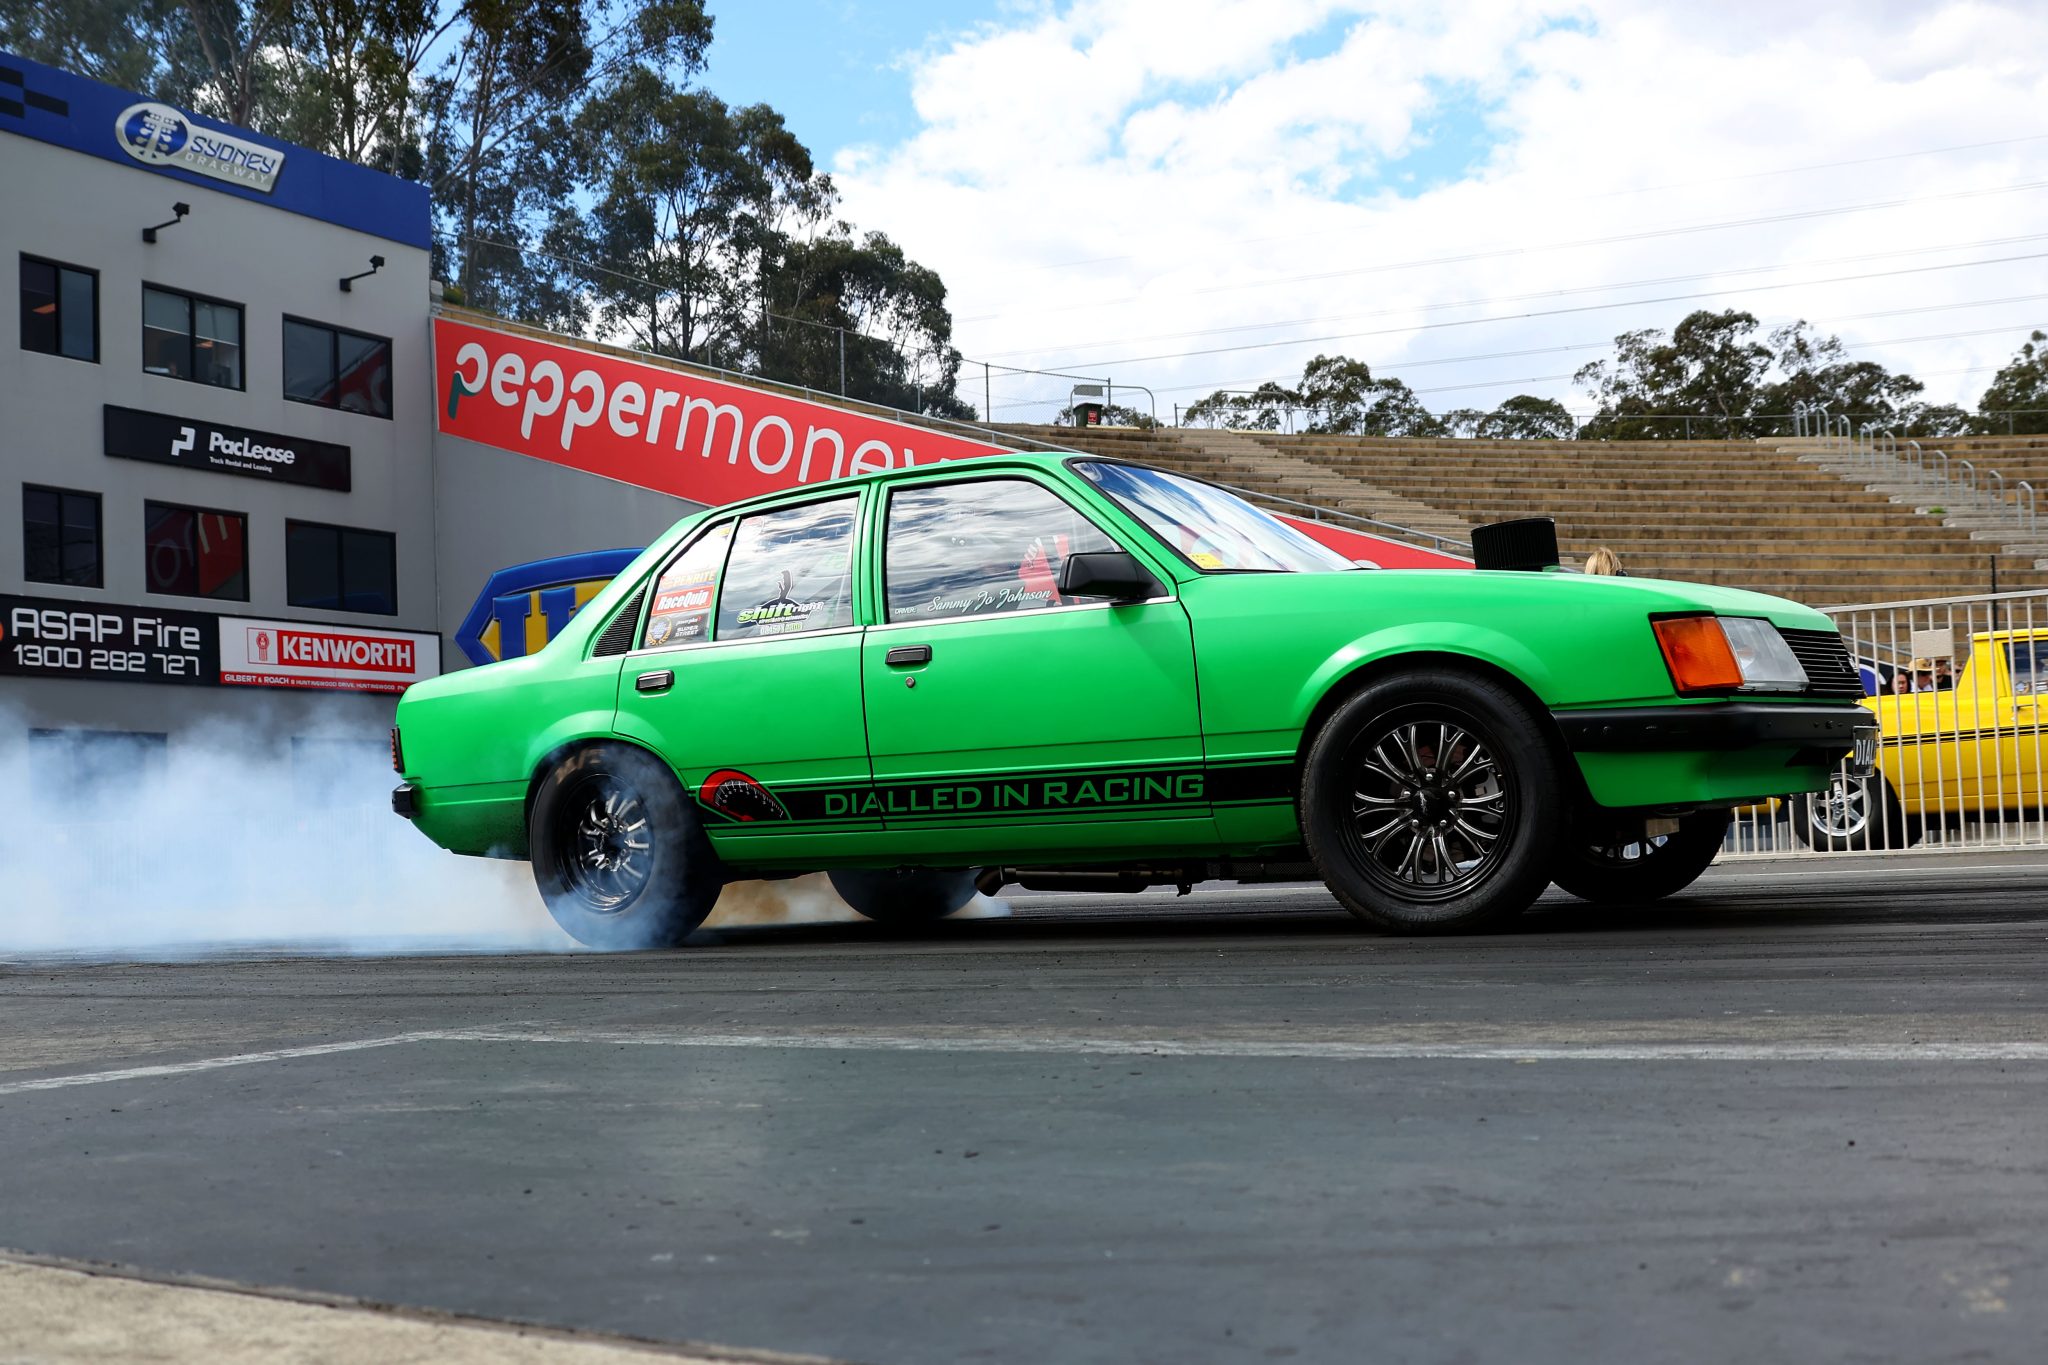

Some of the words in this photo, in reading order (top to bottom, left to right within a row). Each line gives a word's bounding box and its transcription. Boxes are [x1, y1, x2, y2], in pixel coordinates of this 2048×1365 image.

[184, 152, 268, 183] DRAGWAY
[190, 136, 276, 174] SYDNEY
[209, 431, 295, 464] PacLease
[209, 456, 224, 465] Truck
[225, 458, 241, 468] Rental
[242, 460, 252, 469] and
[253, 463, 273, 473] Leasing
[656, 589, 710, 610] RaceQuip
[927, 595, 974, 613] Sammy
[974, 590, 996, 612] Jo
[996, 586, 1053, 609] Johnson
[11, 607, 123, 643] ASAP
[133, 617, 200, 650] Fire
[675, 629, 699, 638] STREET
[676, 624, 699, 632] SUPER
[13, 644, 82, 669] 1300
[90, 649, 146, 672] 282
[152, 653, 200, 676] 727
[282, 635, 411, 668] KENWORTH
[224, 674, 257, 683] GILBERT
[263, 676, 289, 685] ROACH
[825, 786, 982, 815] DIALLED
[993, 783, 1029, 807] IN
[1043, 774, 1204, 805] RACING
